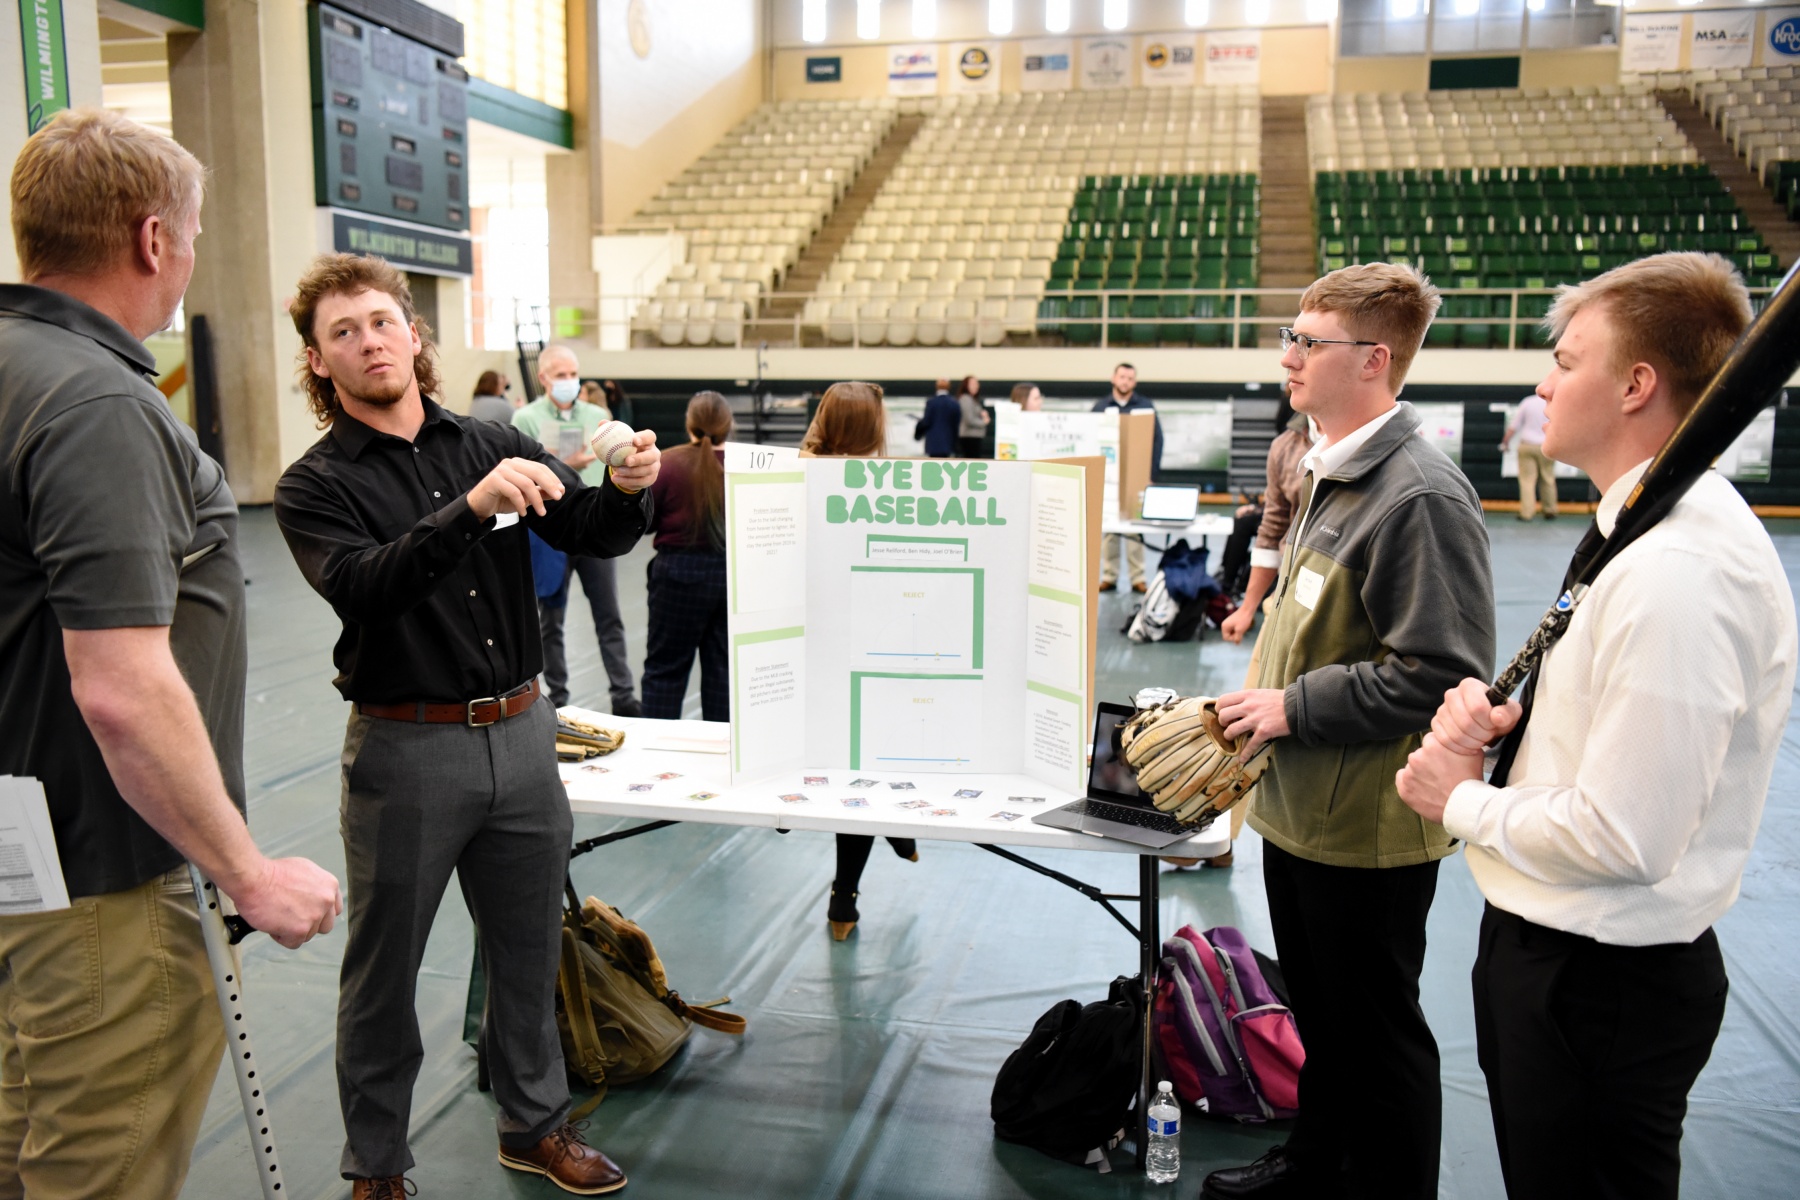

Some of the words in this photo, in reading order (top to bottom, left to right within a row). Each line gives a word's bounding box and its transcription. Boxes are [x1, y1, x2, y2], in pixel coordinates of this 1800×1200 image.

[1695, 30, 1727, 41] MSA
[348, 227, 416, 259] WILMINGTON
[418, 240, 460, 266] COLLEGE
[750, 451, 775, 470] 107
[844, 459, 913, 490] BYE
[920, 461, 989, 492] BYE
[826, 494, 1007, 526] BASEBALL
